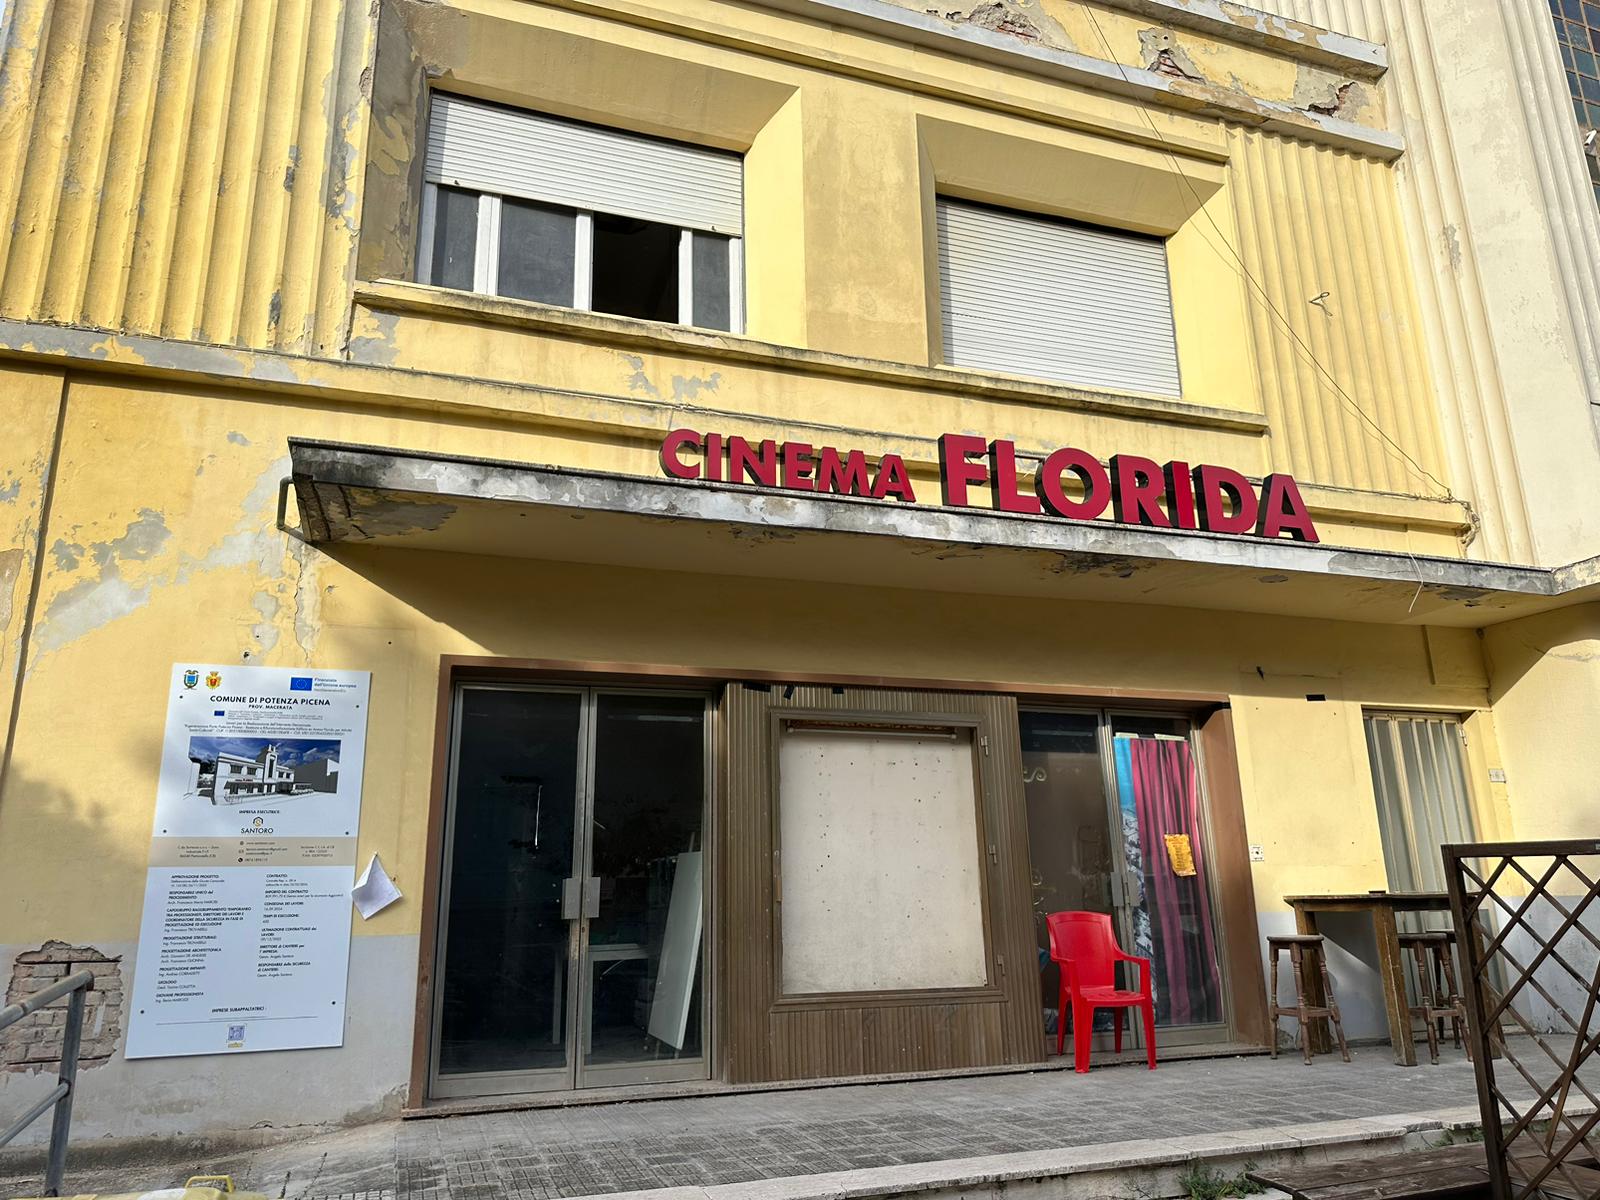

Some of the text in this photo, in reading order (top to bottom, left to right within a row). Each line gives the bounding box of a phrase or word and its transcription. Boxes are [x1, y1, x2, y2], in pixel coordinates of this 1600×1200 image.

[660, 428, 1320, 543] CINEMA FLORIDA
[210, 695, 331, 706] COMUNE DI POTENZA PICENA
